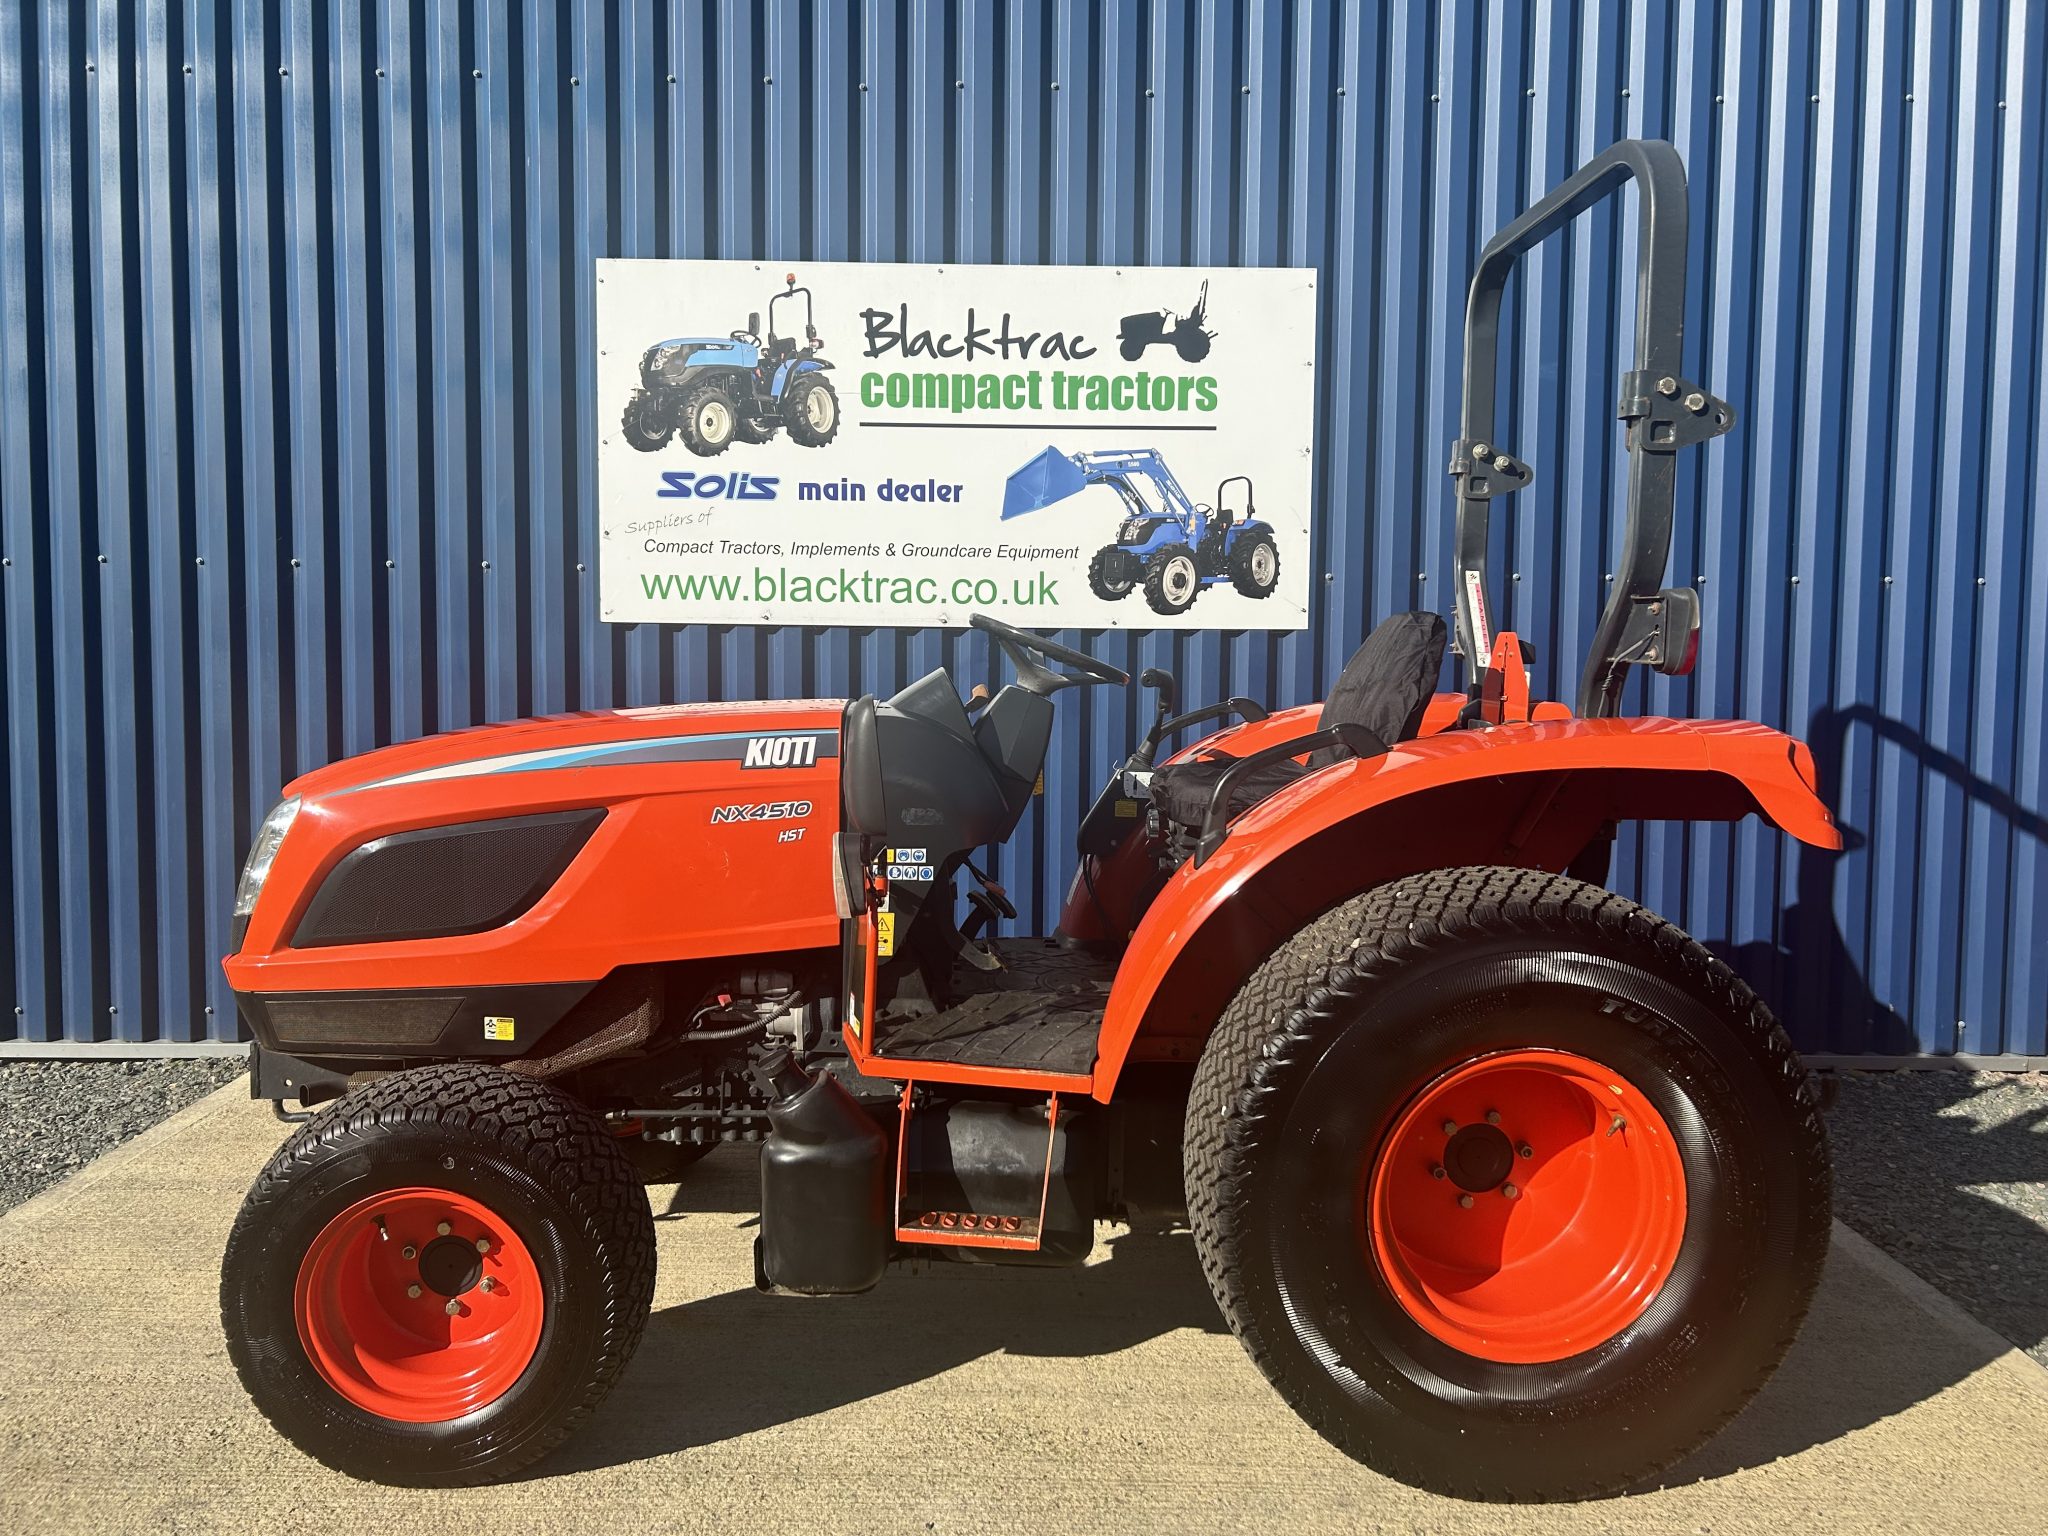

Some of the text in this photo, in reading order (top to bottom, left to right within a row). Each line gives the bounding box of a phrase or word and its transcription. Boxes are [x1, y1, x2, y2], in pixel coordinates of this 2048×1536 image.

[859, 303, 1097, 361] Blacktrac
[860, 371, 1218, 413] compact tractors
[798, 478, 866, 501] main
[877, 478, 964, 502] dealer
[624, 507, 715, 540] Suppliers of
[644, 538, 1079, 561] Compact Tractors, Implements & Groundcare Equipment
[641, 566, 1060, 606] www.blacktrac.co.uk
[745, 736, 817, 767] KIOTI
[711, 801, 812, 823] NX4510
[778, 828, 806, 843] HST
